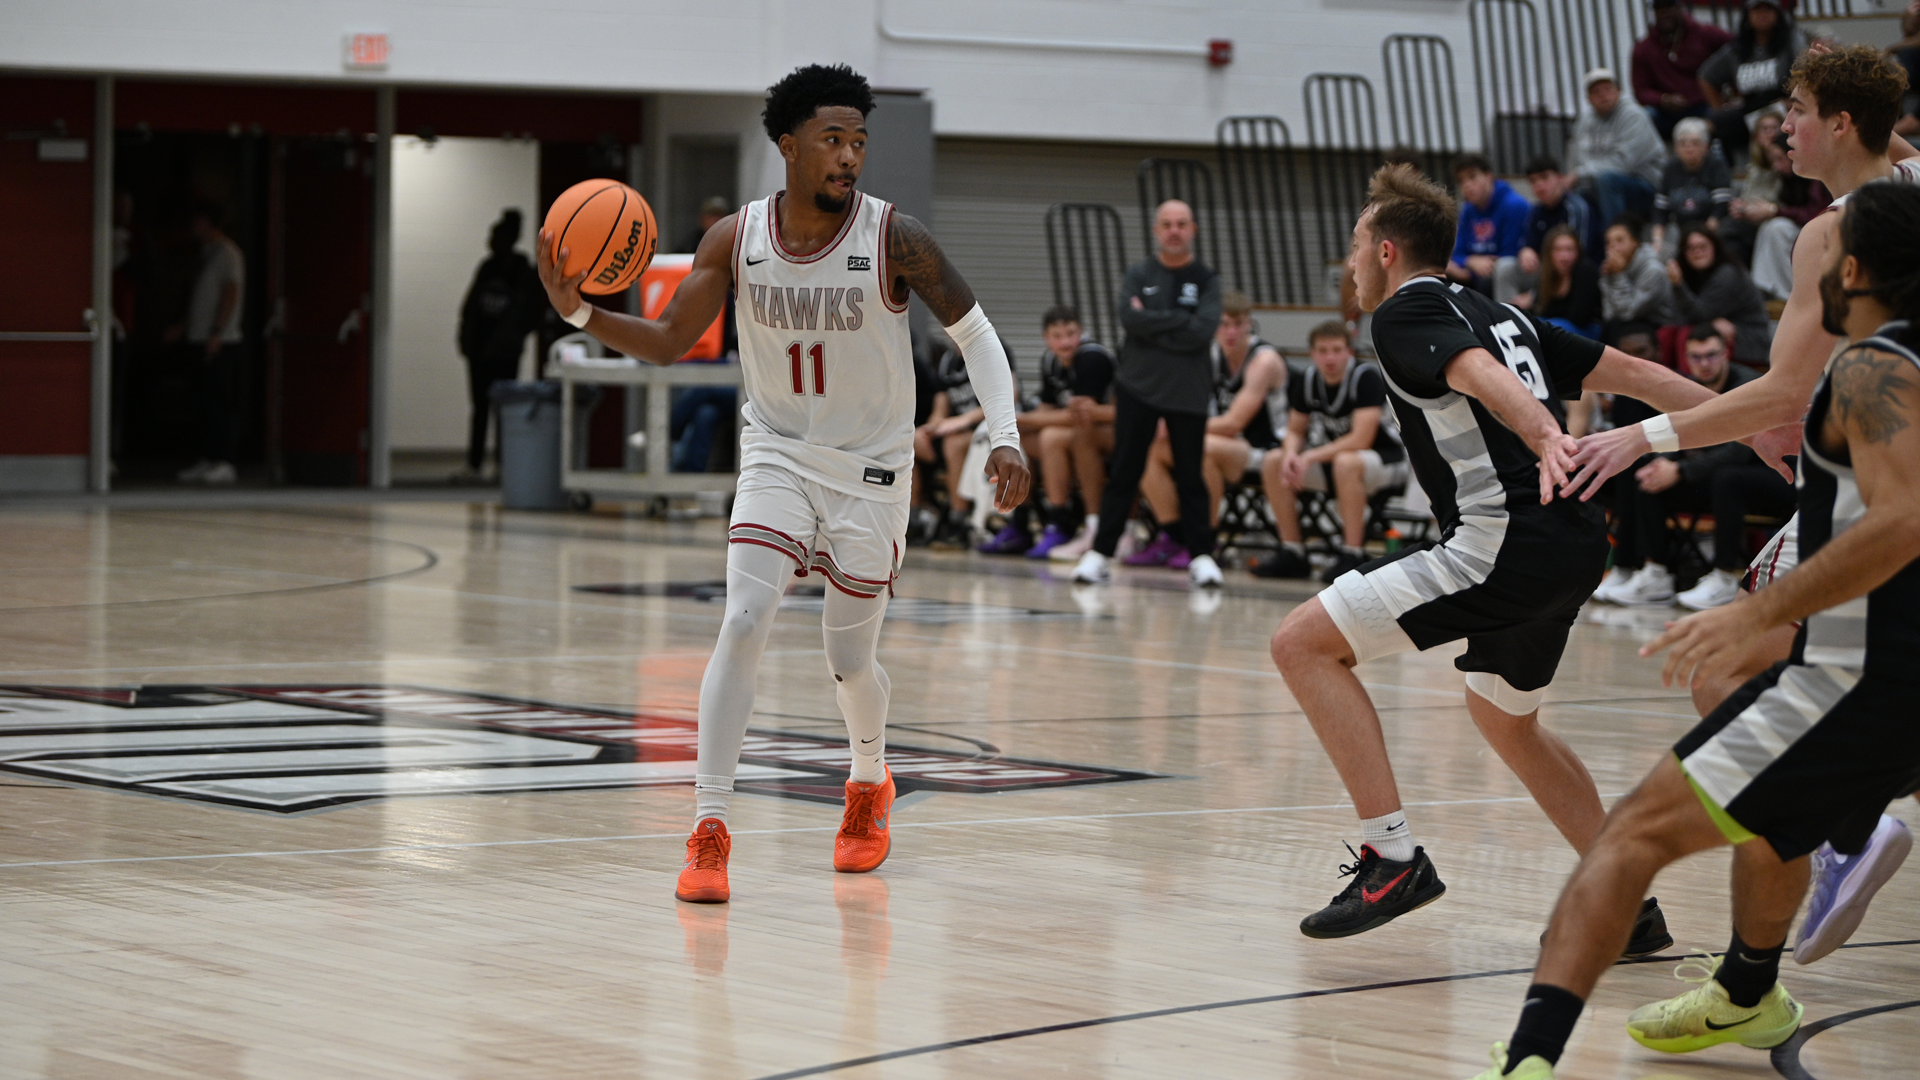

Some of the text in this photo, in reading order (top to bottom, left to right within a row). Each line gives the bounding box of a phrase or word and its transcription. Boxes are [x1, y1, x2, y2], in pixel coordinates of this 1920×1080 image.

[593, 219, 643, 286] Wilson
[847, 259, 871, 268] PSAC
[748, 283, 864, 331] HAWKS
[785, 340, 827, 397] 11
